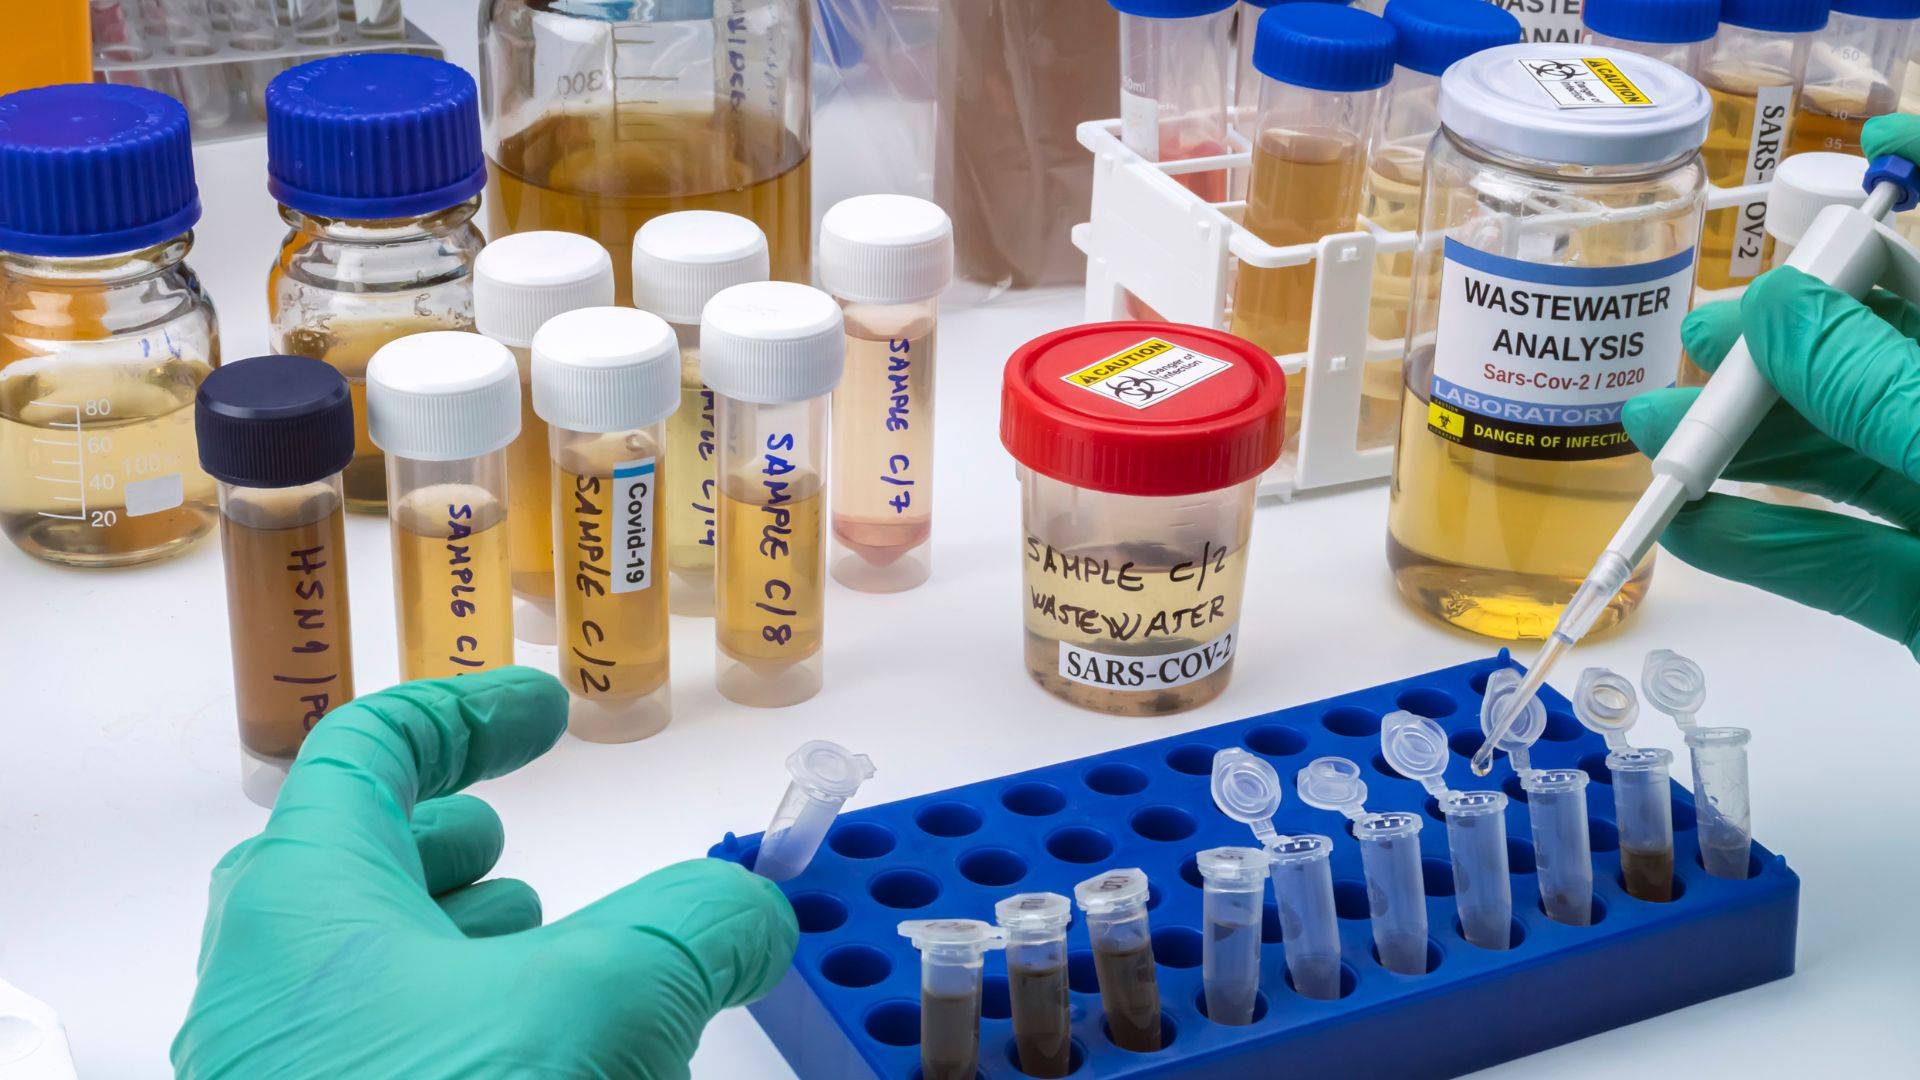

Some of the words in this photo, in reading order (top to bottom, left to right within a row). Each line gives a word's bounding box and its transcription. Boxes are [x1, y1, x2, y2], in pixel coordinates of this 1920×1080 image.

[1491, 0, 1580, 14] ASTE
[1598, 67, 1643, 102] CAUTION
[1825, 138, 1842, 149] 35
[1738, 105, 1785, 259] SARS-OV-2
[1464, 276, 1671, 322] WASTEWATER
[1099, 342, 1167, 377] CAUTION
[1492, 328, 1645, 362] ANALYSIS
[886, 338, 911, 432] SAMPLE
[1149, 358, 1183, 376] Danger
[1483, 363, 1589, 390] Sars-Cov-2
[1606, 367, 1645, 389] 2020
[85, 399, 111, 415] 80
[1435, 380, 1621, 424] LABORATORY
[88, 437, 112, 453] 60
[1473, 423, 1535, 447] DANGER
[1540, 435, 1561, 448] OF
[1566, 431, 1630, 448] INFECTIO
[90, 474, 114, 490] 40
[760, 433, 796, 560] SAMPLE
[880, 454, 915, 513] C/7
[91, 511, 117, 527] 20
[575, 474, 611, 598] SAMPLE
[625, 482, 647, 584] Covid-19
[1027, 535, 1144, 592] SAMPLE
[756, 579, 797, 646] C/8
[1031, 586, 1225, 641] WASTEWATER
[449, 635, 485, 676] C/
[573, 620, 616, 694] C/2
[1067, 634, 1232, 686] SARS-COV-2
